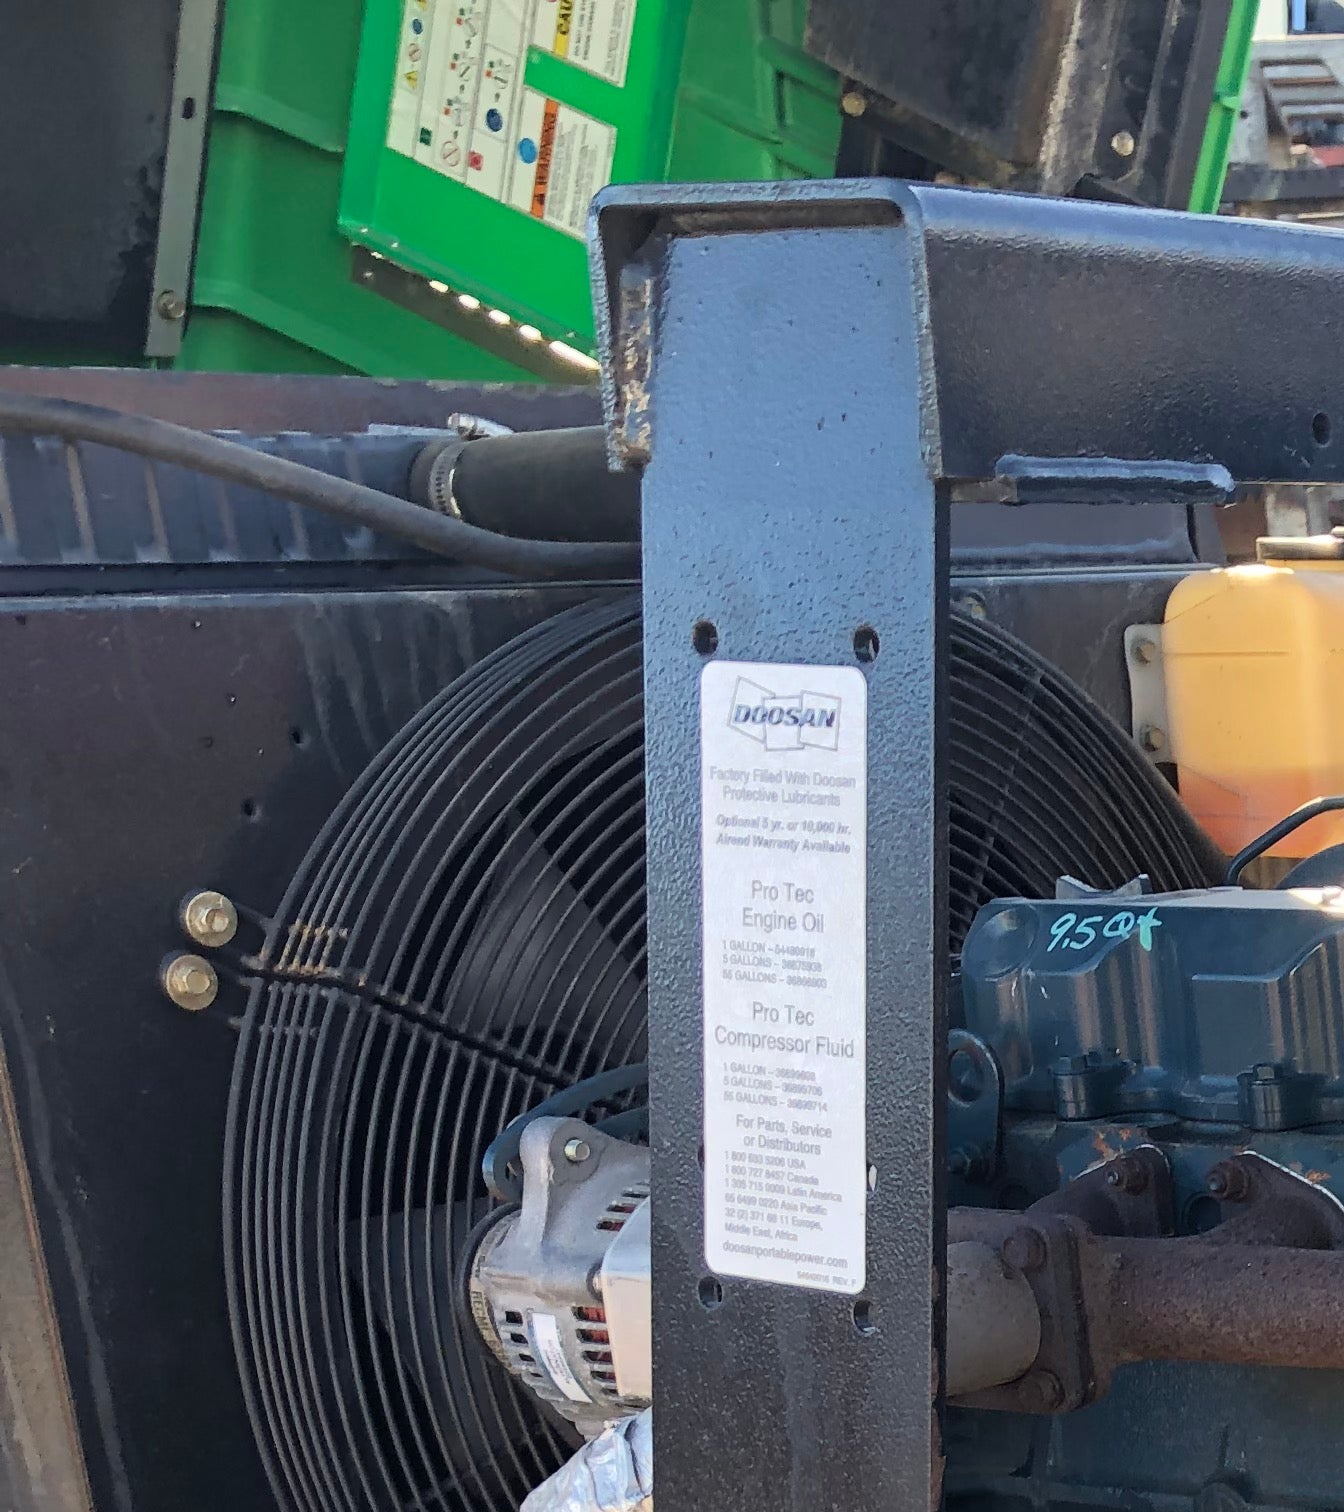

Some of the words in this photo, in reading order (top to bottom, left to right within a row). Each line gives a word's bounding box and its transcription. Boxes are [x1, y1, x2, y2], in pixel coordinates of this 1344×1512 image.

[732, 704, 837, 728] DOOSAN
[709, 766, 750, 784] Factory
[753, 768, 783, 784] Filled
[785, 771, 811, 786] With
[813, 772, 856, 788] Doosan
[723, 785, 778, 803] Protective
[782, 788, 841, 806] Lubricants
[716, 814, 760, 830] Optional
[753, 835, 800, 853] Warranty
[802, 839, 852, 855] Available
[751, 879, 779, 902] Pro
[783, 882, 815, 904] Tec
[742, 906, 797, 933] Engine
[802, 912, 825, 933] Oil
[729, 941, 766, 954] GALLON
[730, 954, 772, 968] GALLONS
[734, 970, 777, 984] GALLONS
[752, 1001, 779, 1023] Pro
[784, 1004, 815, 1026] Tec
[715, 1024, 810, 1054] Compressor
[815, 1035, 855, 1059] Fluid
[730, 1062, 766, 1076] GALLON
[731, 1077, 773, 1091] GALLONS
[735, 1092, 778, 1107] GALLONS
[736, 1114, 755, 1129] For
[791, 1121, 832, 1139] Service
[743, 1135, 756, 1147] or
[758, 1135, 822, 1155] Distributors
[787, 1158, 806, 1170] USA
[748, 1167, 763, 1178] 727
[787, 1171, 819, 1186] Canada
[809, 1189, 843, 1202] America
[723, 1240, 848, 1269] doosanportablepower.com
